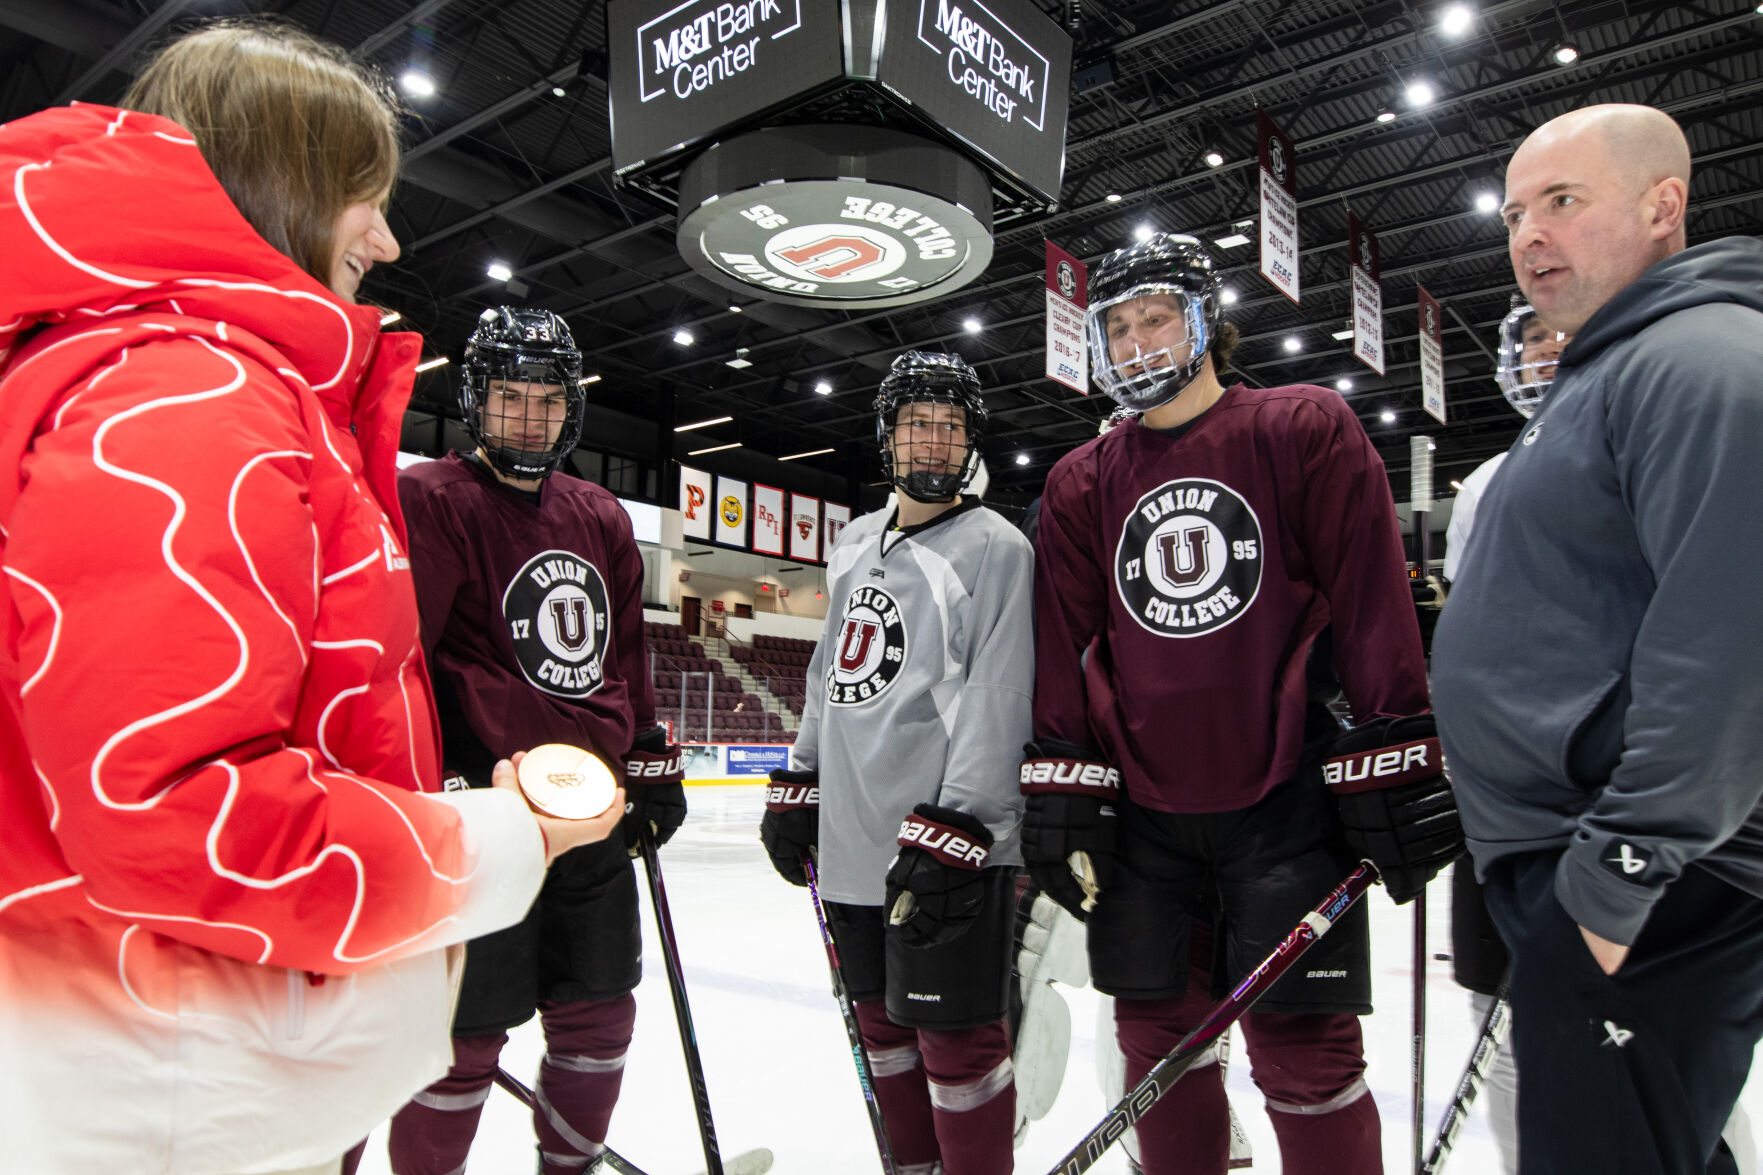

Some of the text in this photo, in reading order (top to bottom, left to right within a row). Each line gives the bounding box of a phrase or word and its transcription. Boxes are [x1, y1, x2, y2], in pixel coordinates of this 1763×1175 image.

[654, 0, 782, 75] M&T Bank
[934, 0, 1035, 103] M&T Bank
[673, 36, 761, 98] Center
[947, 47, 1018, 123] Center
[840, 196, 958, 260] COLLEGE
[1273, 260, 1292, 282] ECAC
[524, 326, 552, 341] 33
[1058, 363, 1079, 379] ECAC
[685, 483, 705, 520] P
[1140, 488, 1219, 524] UNION
[758, 504, 779, 536] RPI
[1156, 525, 1210, 589] U
[1232, 539, 1258, 560] 95
[530, 559, 588, 588] UNION
[1125, 557, 1141, 581] 17
[1144, 585, 1241, 627] COLLEGE
[511, 618, 530, 640] 17
[549, 597, 589, 652] U
[839, 617, 881, 674] U
[885, 645, 903, 663] 95
[1306, 970, 1348, 979] BAUER
[907, 992, 942, 1002] BAUER
